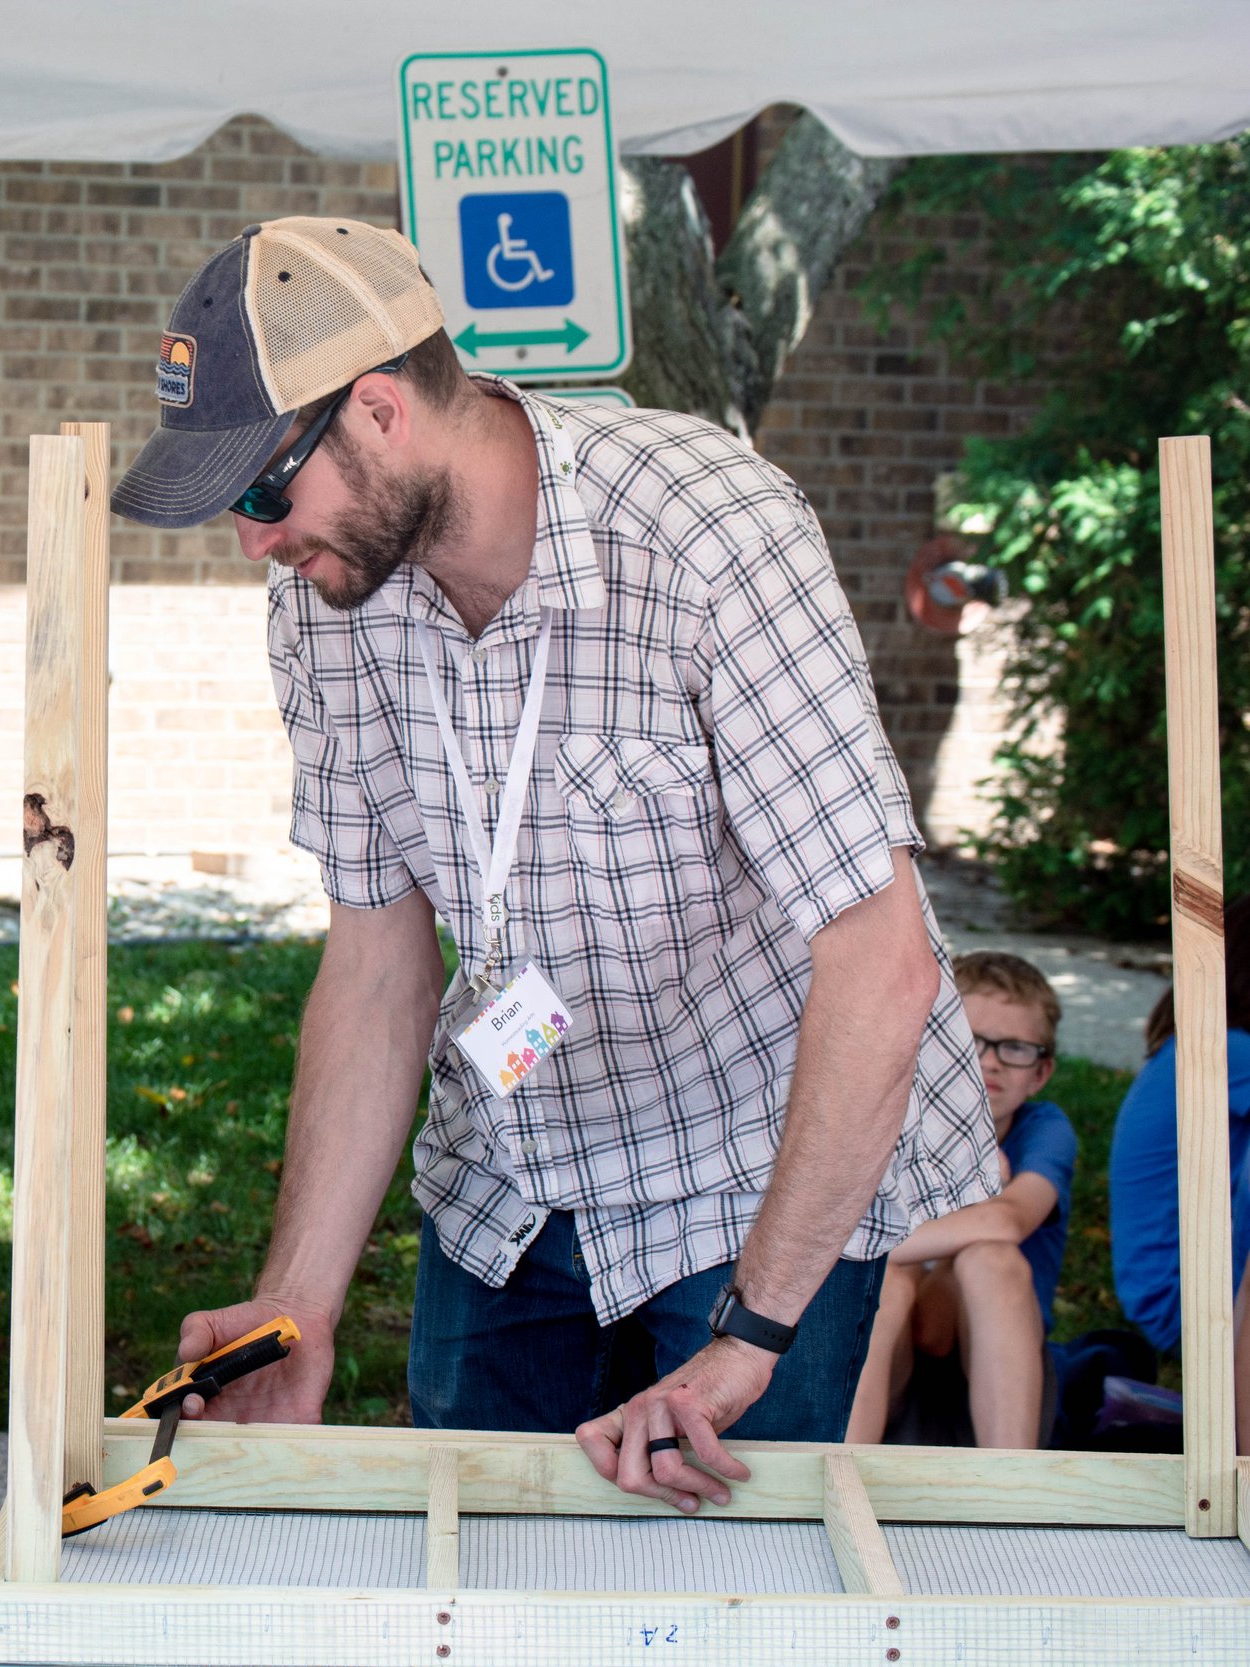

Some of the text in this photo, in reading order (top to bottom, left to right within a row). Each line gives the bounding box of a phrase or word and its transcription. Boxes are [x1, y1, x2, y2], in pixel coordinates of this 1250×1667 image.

[411, 77, 599, 120] RESERVED
[433, 135, 585, 179] PARKING
[490, 893, 503, 922] kids
[490, 1000, 523, 1032] Brian
